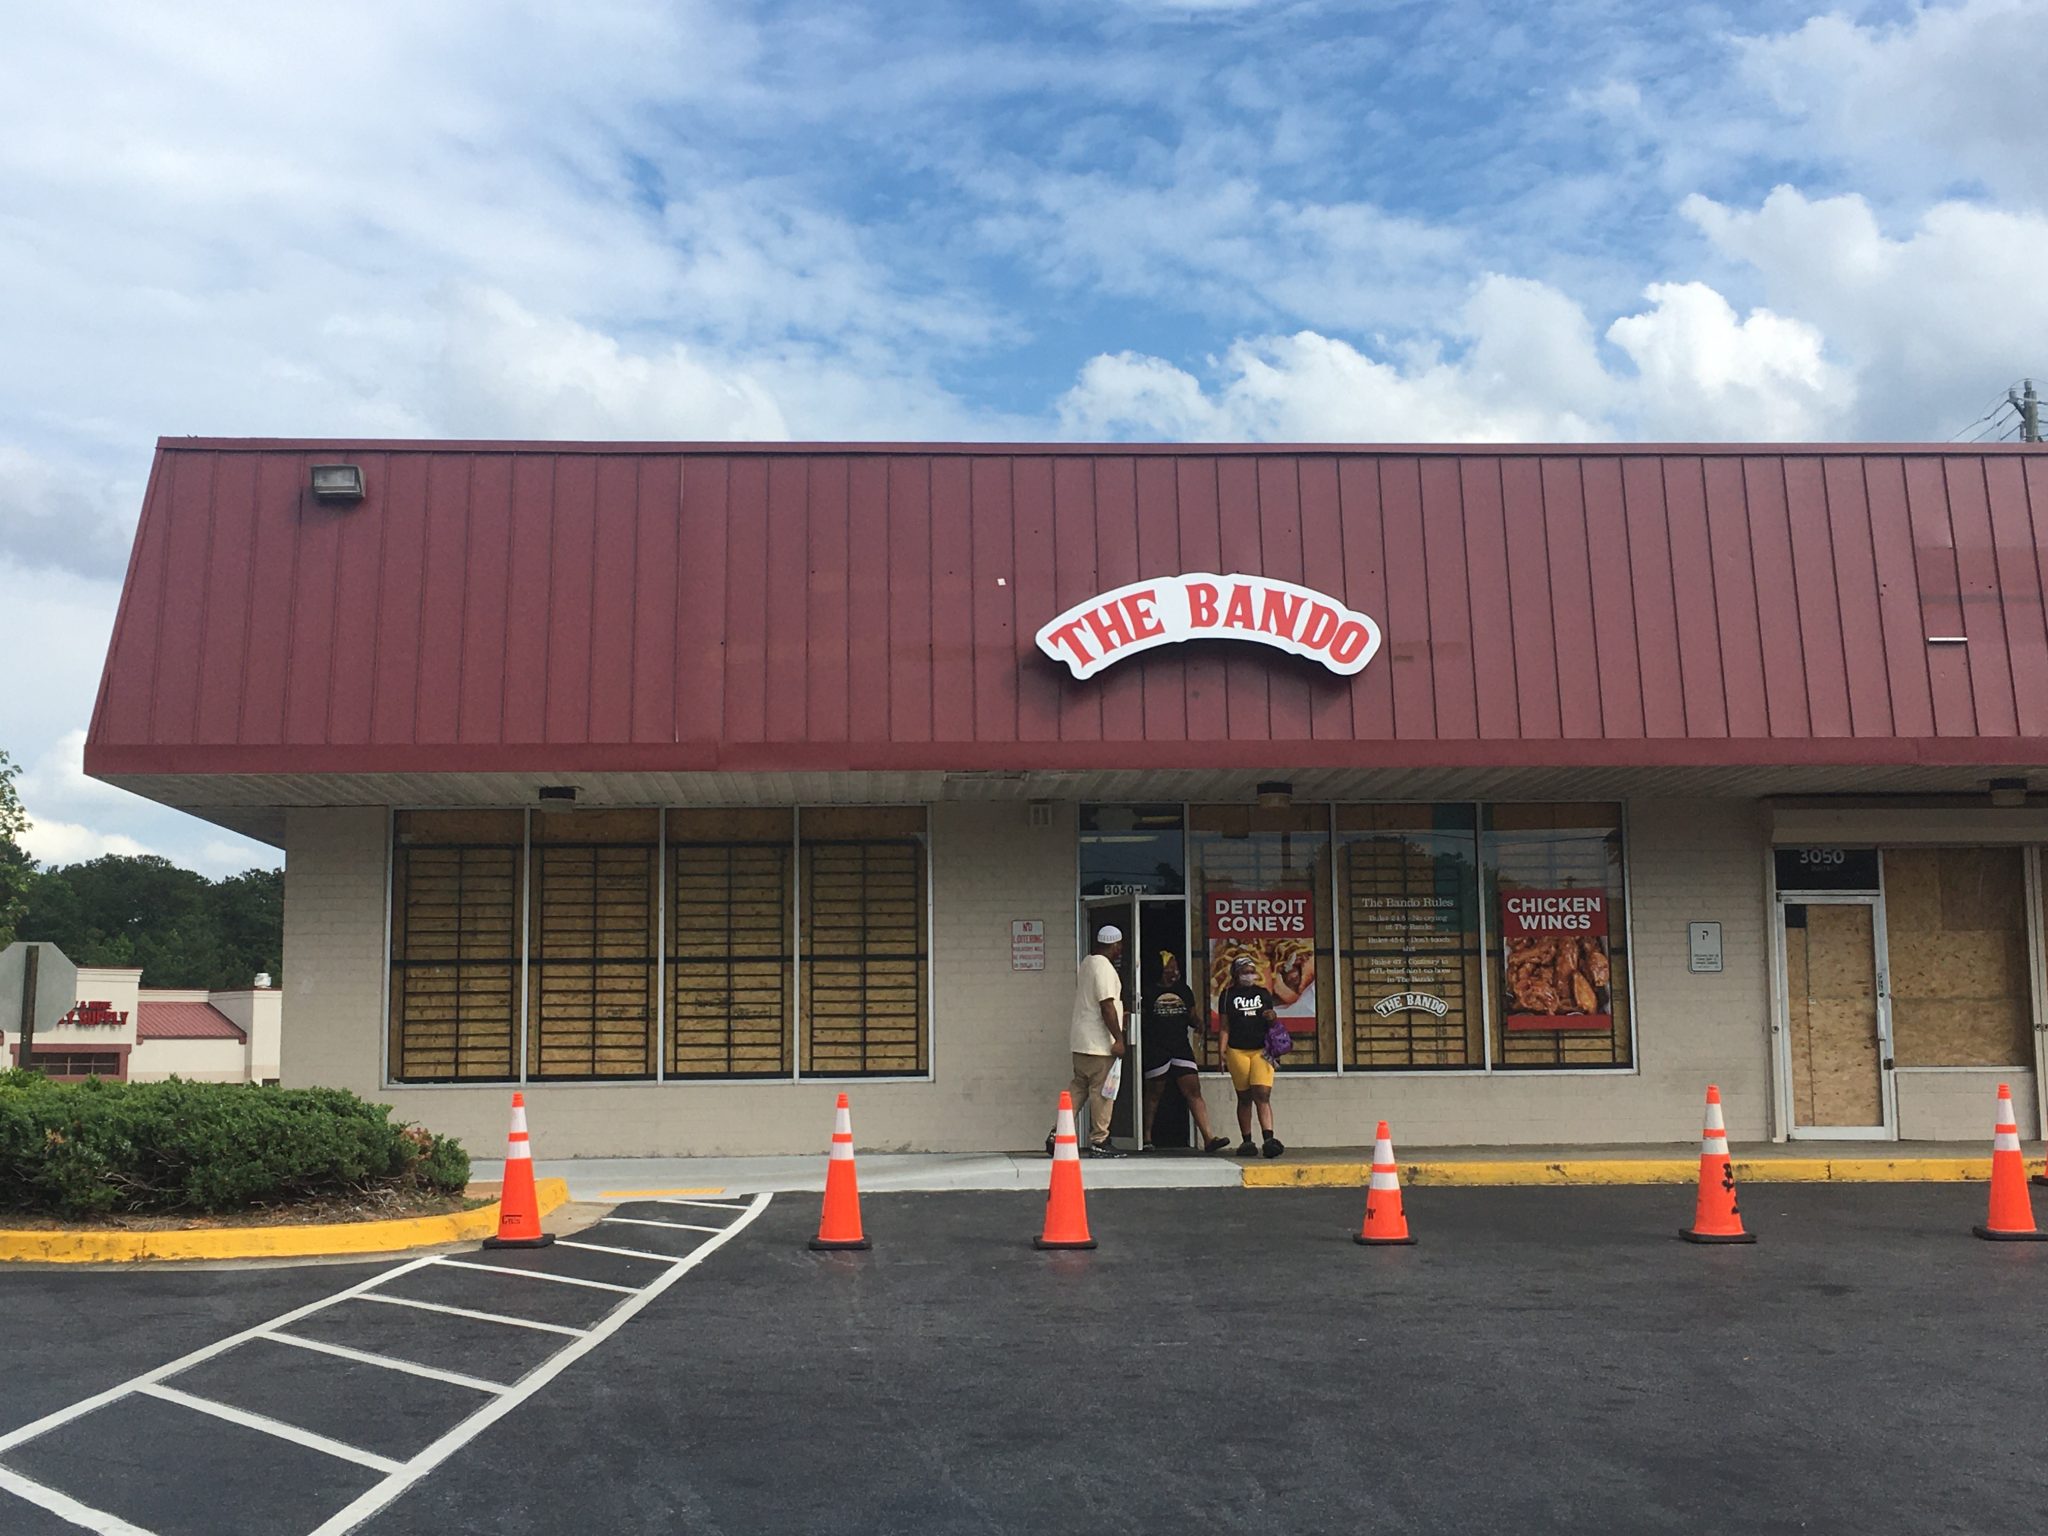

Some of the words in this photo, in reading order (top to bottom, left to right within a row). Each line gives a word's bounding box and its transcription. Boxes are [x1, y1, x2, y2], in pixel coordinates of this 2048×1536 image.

[1047, 590, 1166, 668] THE
[1185, 583, 1370, 665] BANDO
[1799, 850, 1845, 864] 3050
[1215, 899, 1307, 915] DETROIT
[1361, 898, 1383, 907] The
[1385, 898, 1420, 907] Bando
[1423, 898, 1454, 907] Rules
[1507, 897, 1601, 913] CHICKEN
[1022, 922, 1033, 932] NO
[1218, 916, 1305, 932] CONEYS
[1519, 914, 1592, 930] WINGS
[1233, 994, 1263, 1009] Pink
[1377, 996, 1402, 1014] THE
[1406, 994, 1446, 1013] BANDO
[80, 1010, 129, 1025] SUPPLY
